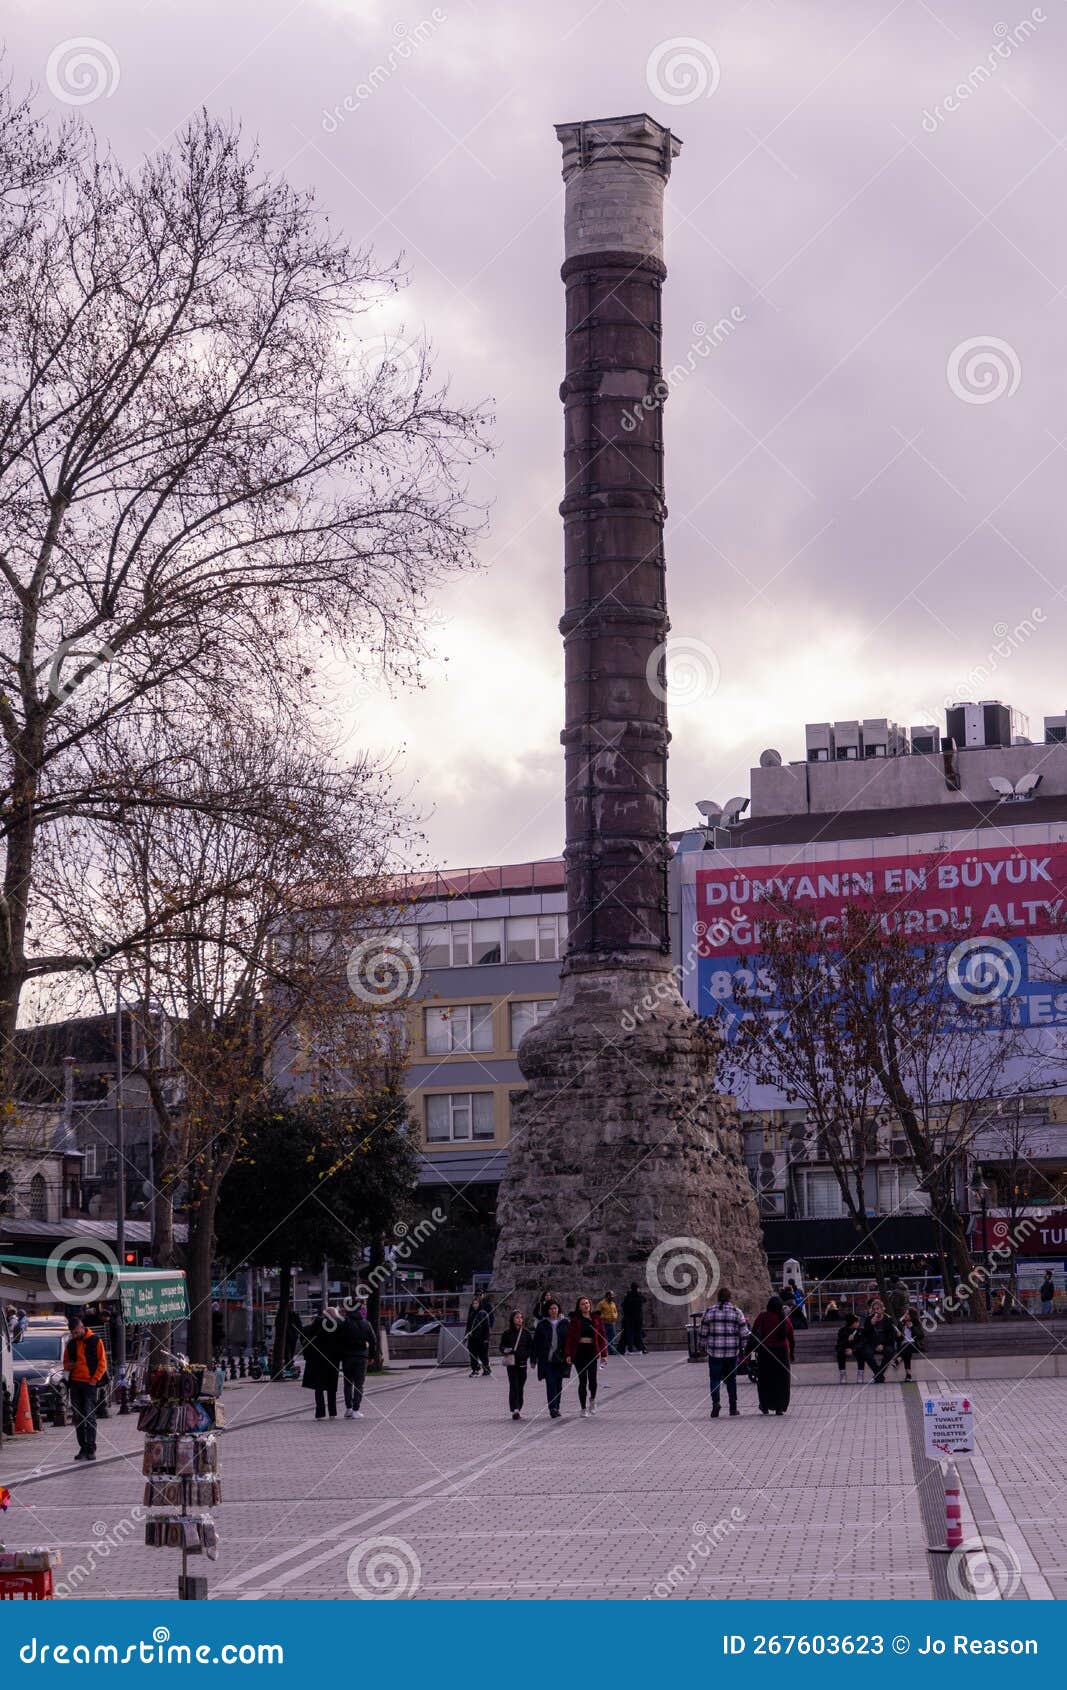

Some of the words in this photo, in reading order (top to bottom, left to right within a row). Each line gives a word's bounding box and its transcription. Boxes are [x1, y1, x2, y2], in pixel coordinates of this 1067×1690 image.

[885, 867, 927, 893] EN
[938, 853, 1053, 889] BÜYÜK
[862, 906, 973, 935] URDU
[982, 899, 1067, 928] ALTY
[1040, 1228, 1067, 1245] TU
